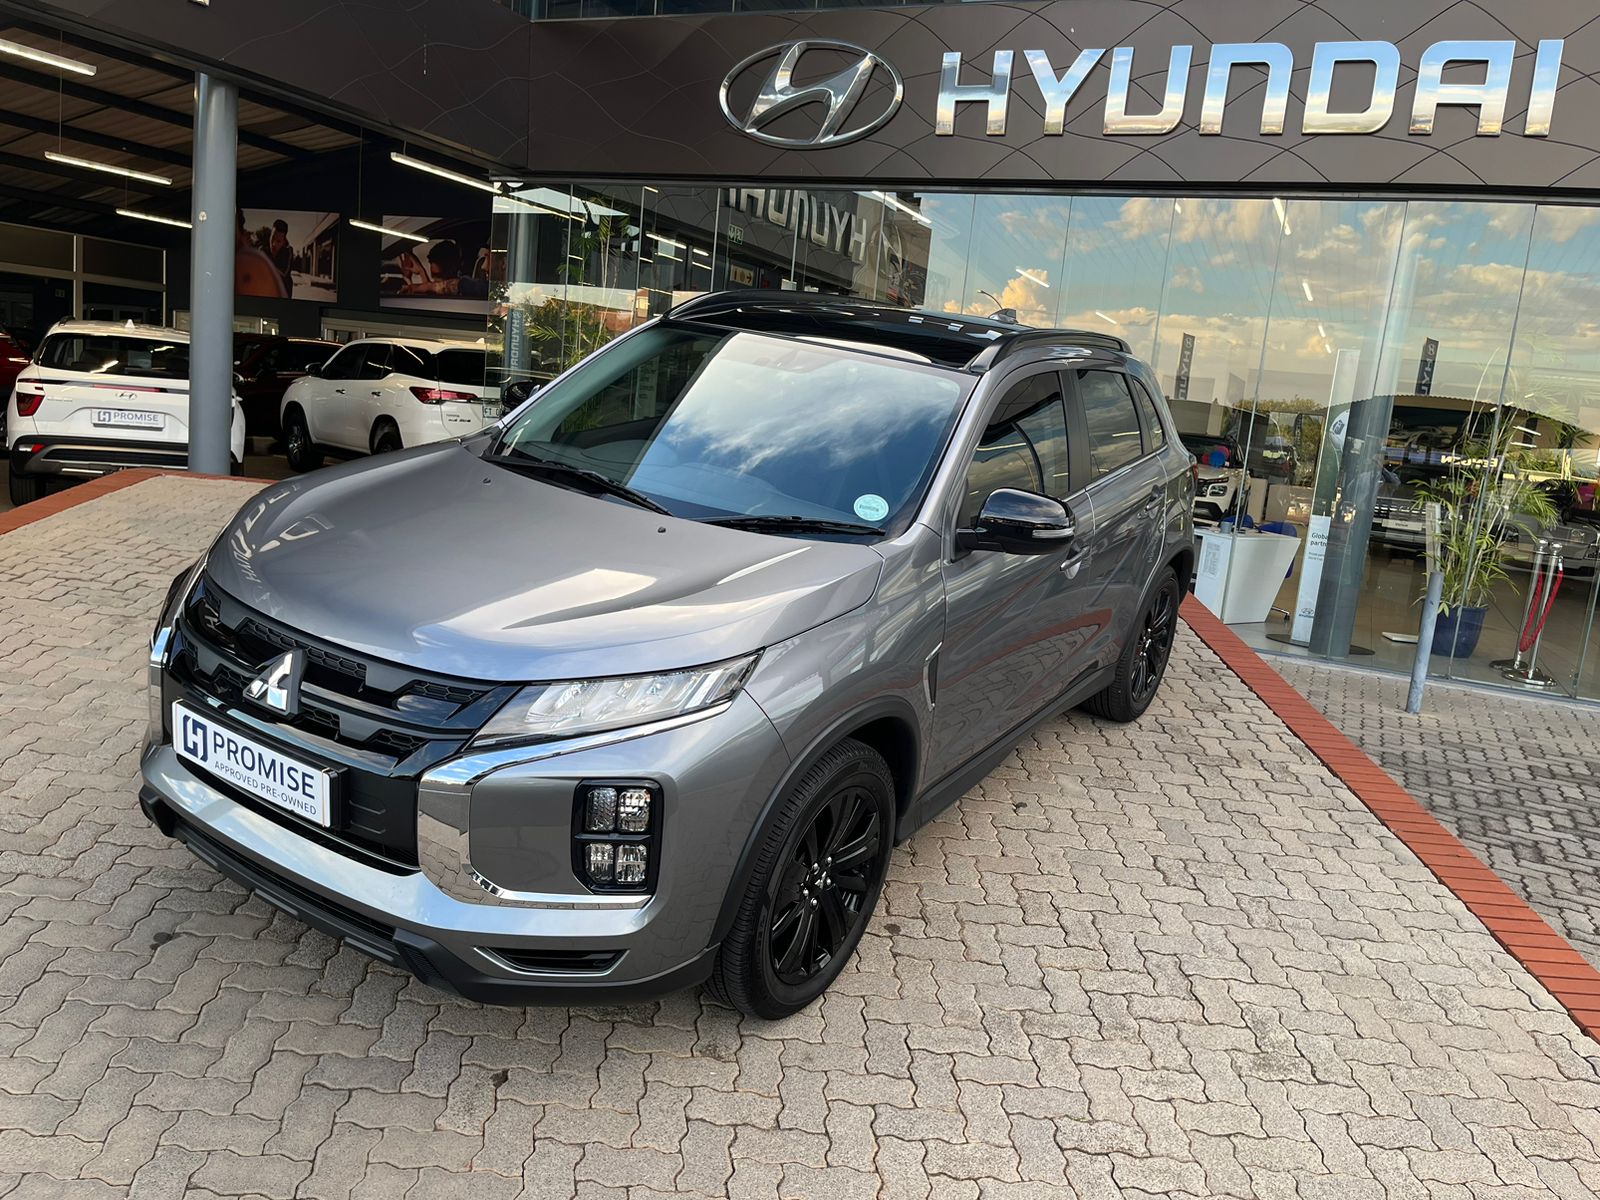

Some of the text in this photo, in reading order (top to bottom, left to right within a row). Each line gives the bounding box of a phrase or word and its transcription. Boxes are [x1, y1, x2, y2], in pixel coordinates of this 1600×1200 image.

[935, 39, 1564, 136] HYUNDAI
[113, 412, 159, 422] PROMISE
[213, 730, 315, 799] PROMISE
[214, 761, 317, 815] APPROVED PRE-OWNED
